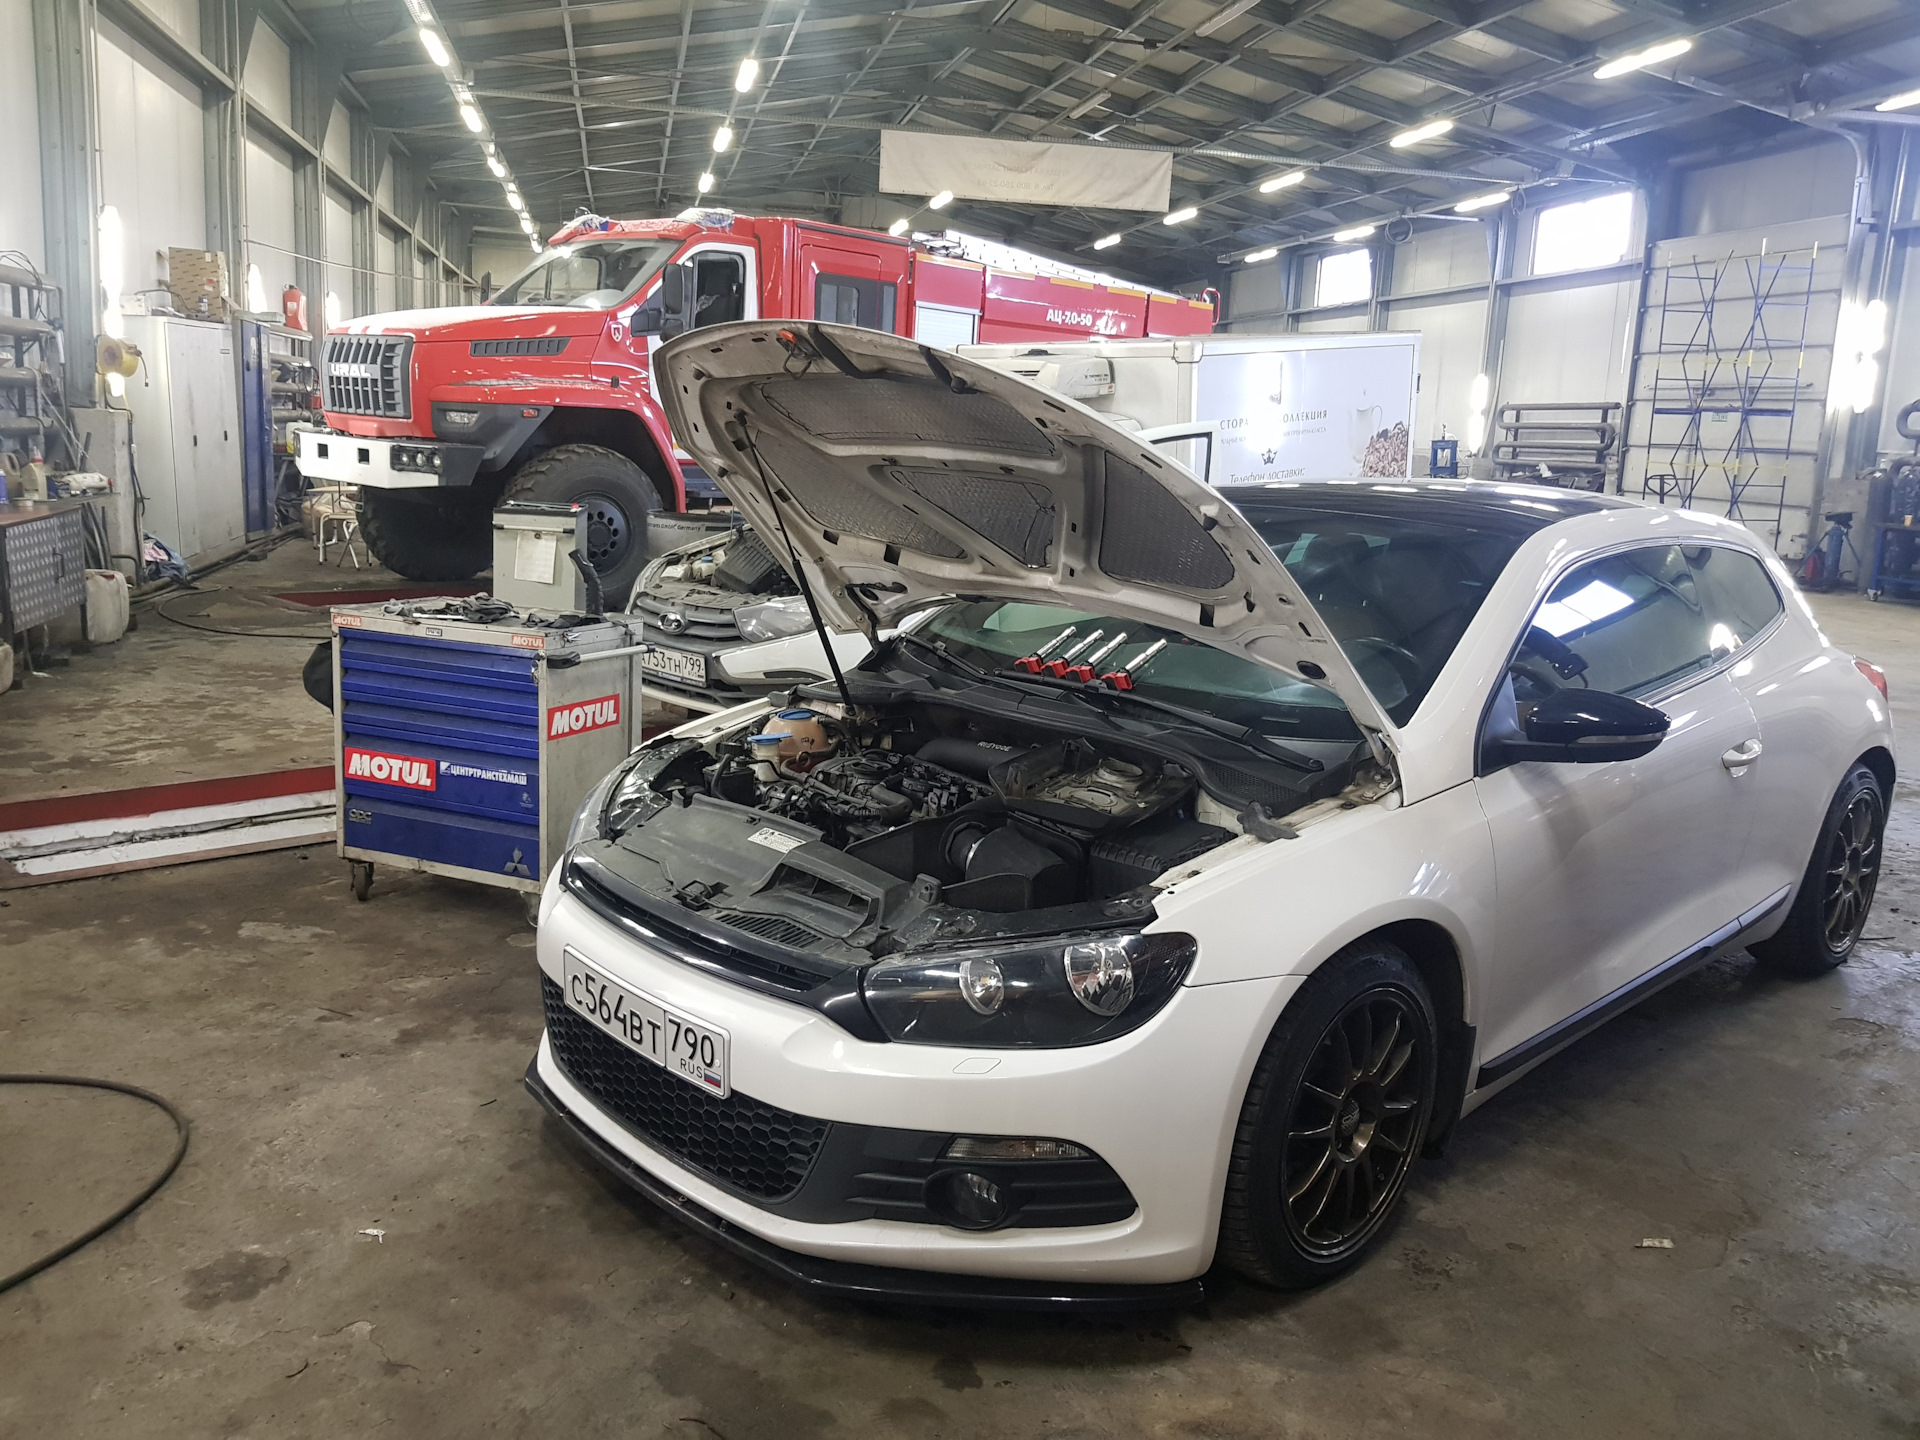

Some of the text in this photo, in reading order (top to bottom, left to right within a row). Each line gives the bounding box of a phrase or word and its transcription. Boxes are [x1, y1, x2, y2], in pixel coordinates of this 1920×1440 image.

[330, 363, 372, 378] URAL
[1282, 409, 1327, 423] ОЛЛЕКЦИЯ
[333, 615, 362, 627] MOTUL
[512, 635, 544, 648] MOTUL
[550, 699, 618, 737] MOTUL
[348, 752, 432, 787] MOTUL
[450, 764, 527, 785] ЦЕНТРТРАНСТЕХМАШ
[668, 1015, 715, 1068] 790
[680, 1057, 703, 1079] RUS
